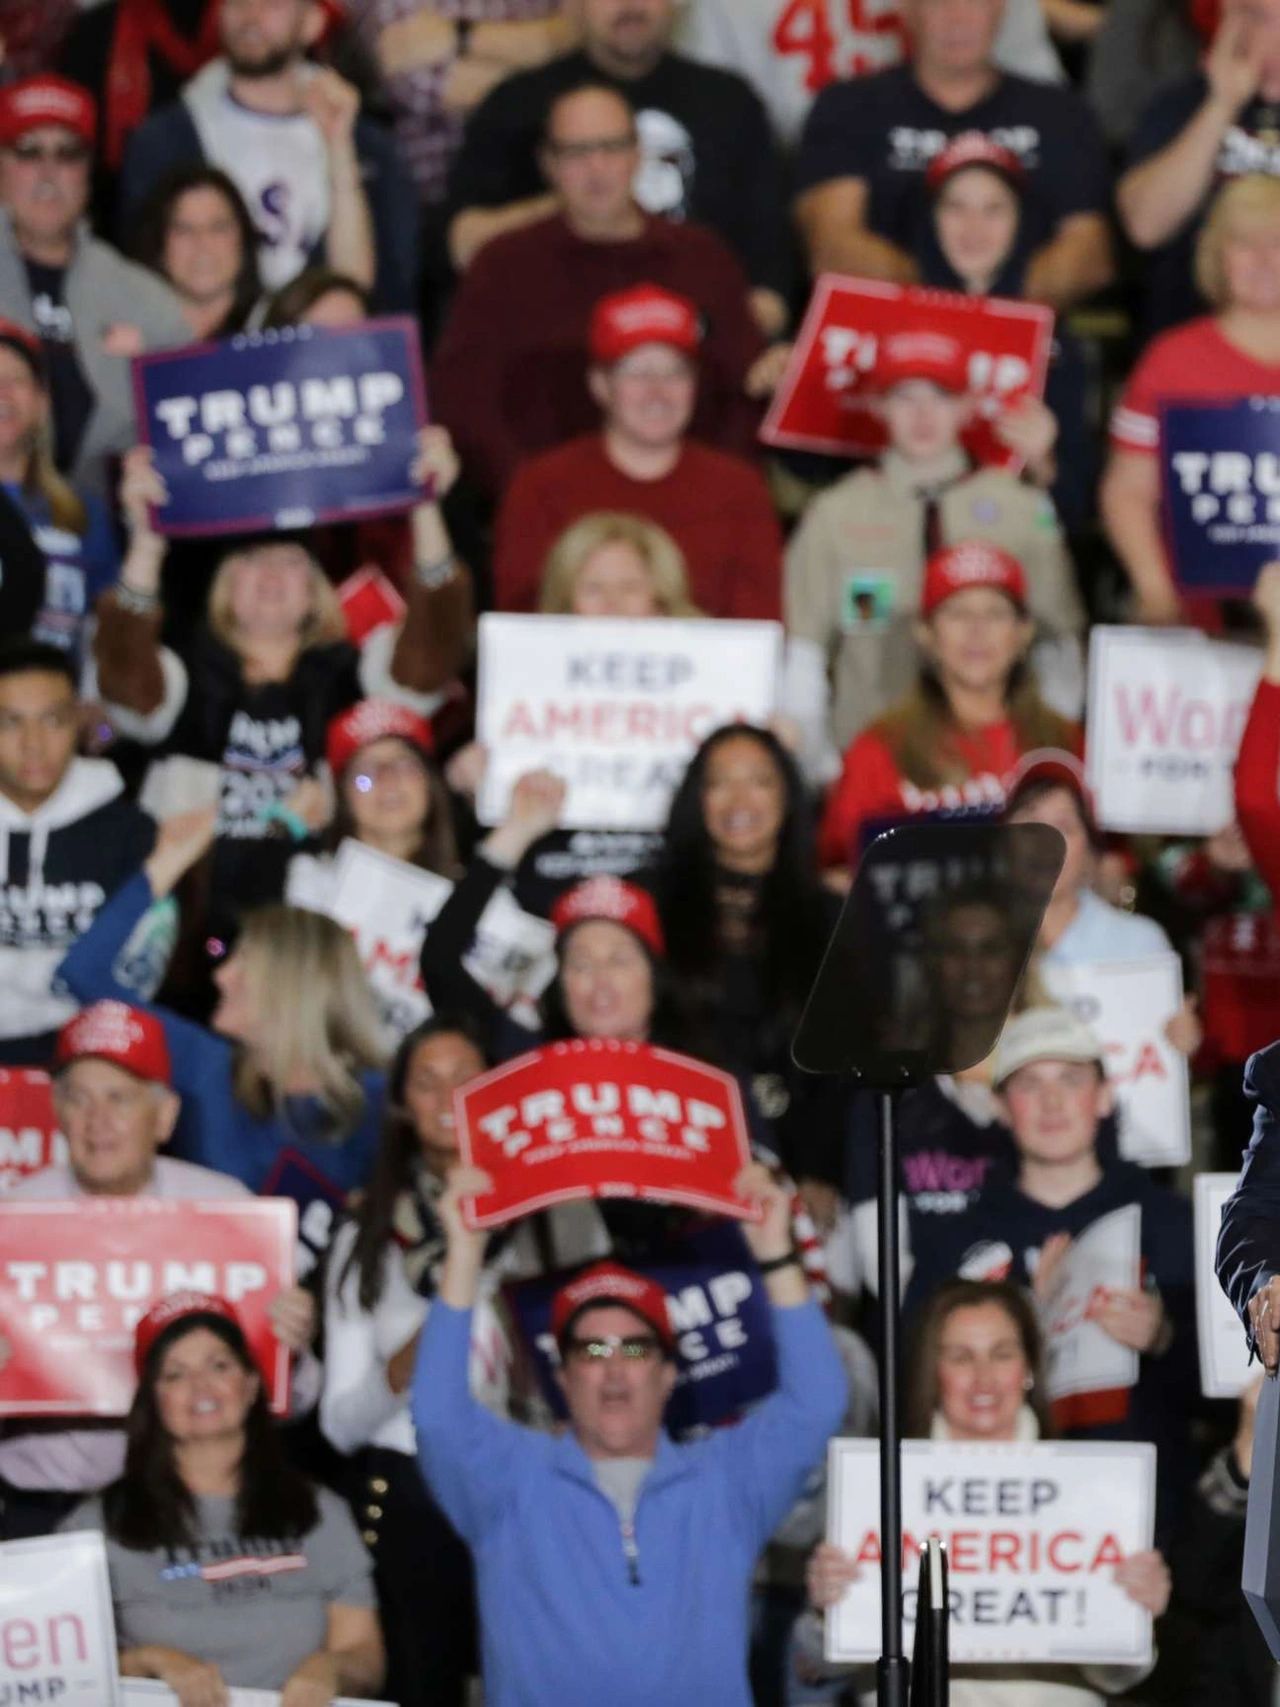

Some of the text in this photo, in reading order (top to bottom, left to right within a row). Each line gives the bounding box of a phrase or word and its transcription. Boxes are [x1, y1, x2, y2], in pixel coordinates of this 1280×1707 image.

[156, 372, 403, 438] TRUMP
[182, 422, 386, 465] PENCE
[565, 653, 695, 689] KEEP
[506, 700, 746, 742] AMERIC
[479, 1082, 725, 1141] TRUMP
[503, 1115, 709, 1157] PENCE
[8, 1262, 265, 1300] TRUMP
[923, 1479, 1059, 1516] KEEP
